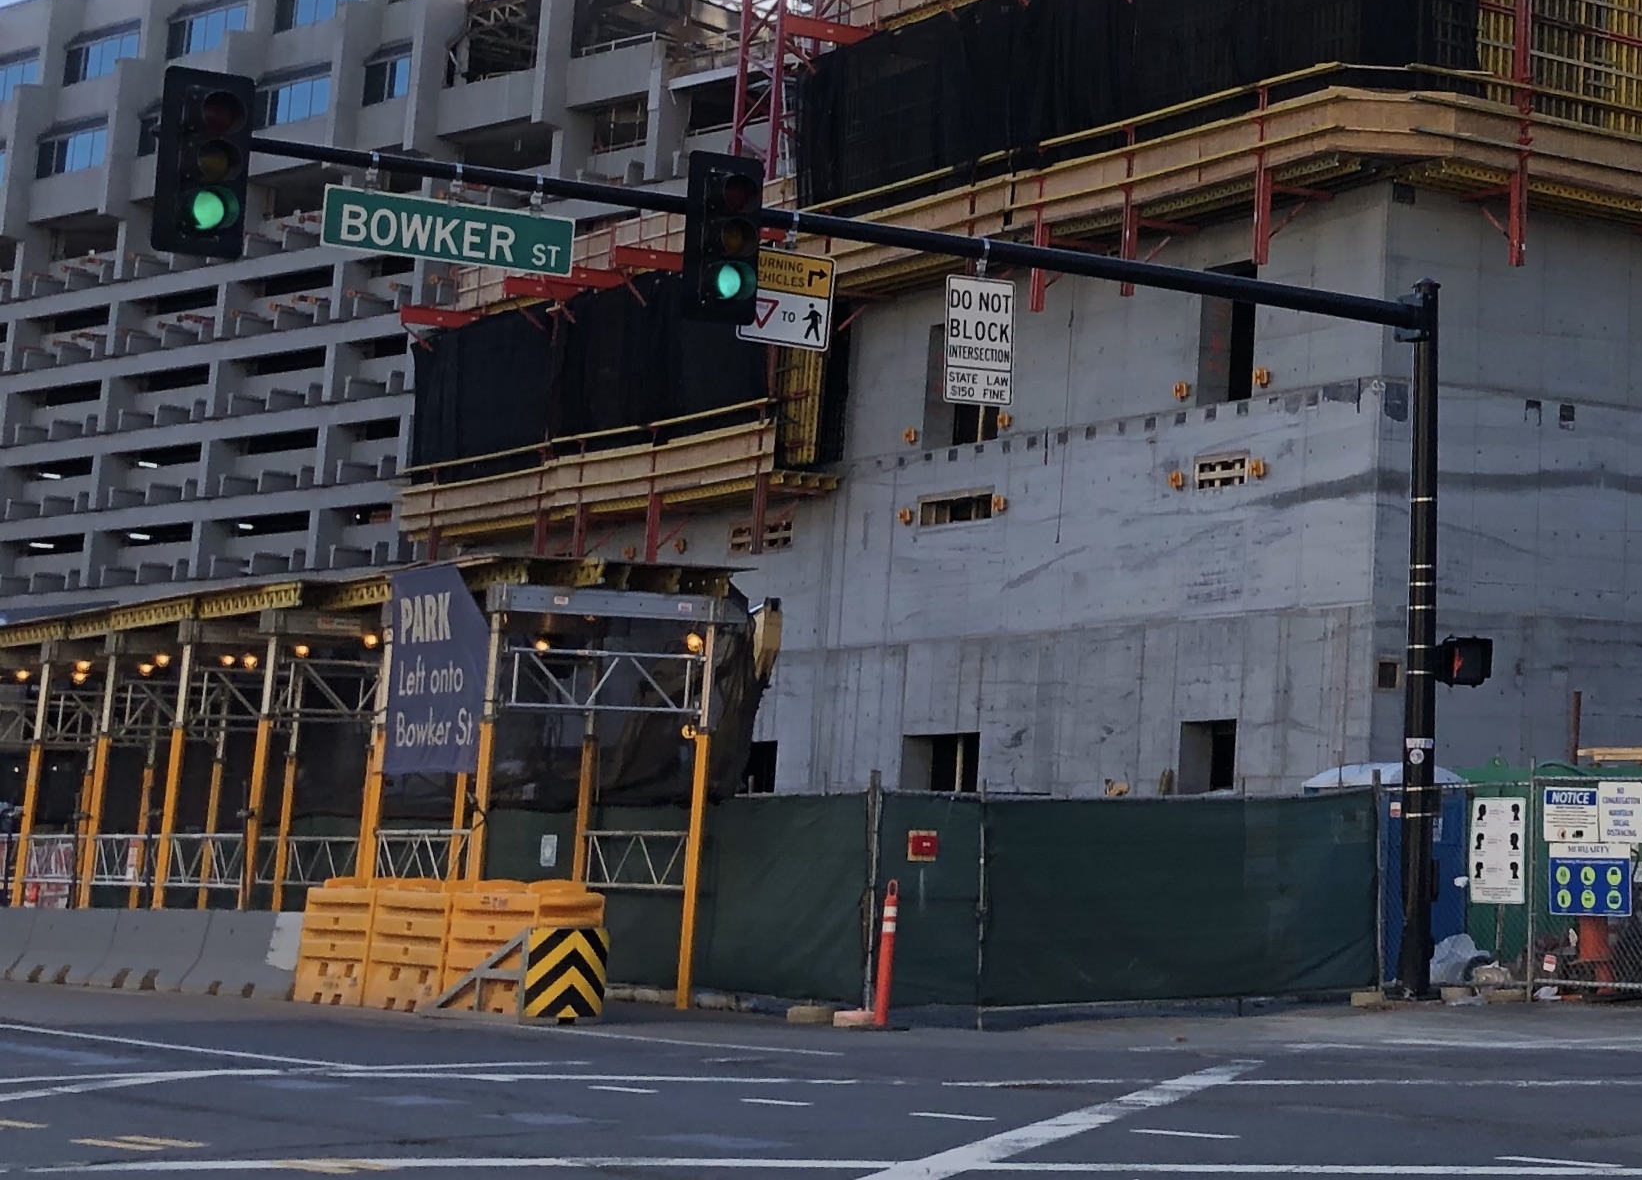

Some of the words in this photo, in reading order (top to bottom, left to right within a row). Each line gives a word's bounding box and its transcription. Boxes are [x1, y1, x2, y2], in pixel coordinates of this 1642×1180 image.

[340, 203, 516, 263] BOWKER
[531, 243, 561, 268] ST
[759, 257, 804, 274] URNING
[758, 271, 805, 288] EHICLES
[950, 289, 972, 310] DO
[979, 292, 1011, 314] NOT
[781, 310, 796, 323] TO
[950, 318, 1010, 343] BLOCK
[949, 344, 1010, 363] INTERSECTION
[948, 371, 978, 384] STATE
[986, 375, 1009, 387] LAW
[950, 385, 975, 398] $150
[983, 388, 1006, 400] FINE
[400, 591, 452, 645] PARK
[398, 654, 426, 697] Left
[430, 661, 464, 695] onto
[395, 706, 452, 748] Bowker
[455, 706, 474, 746] St.
[1551, 791, 1590, 805] NOTICE
